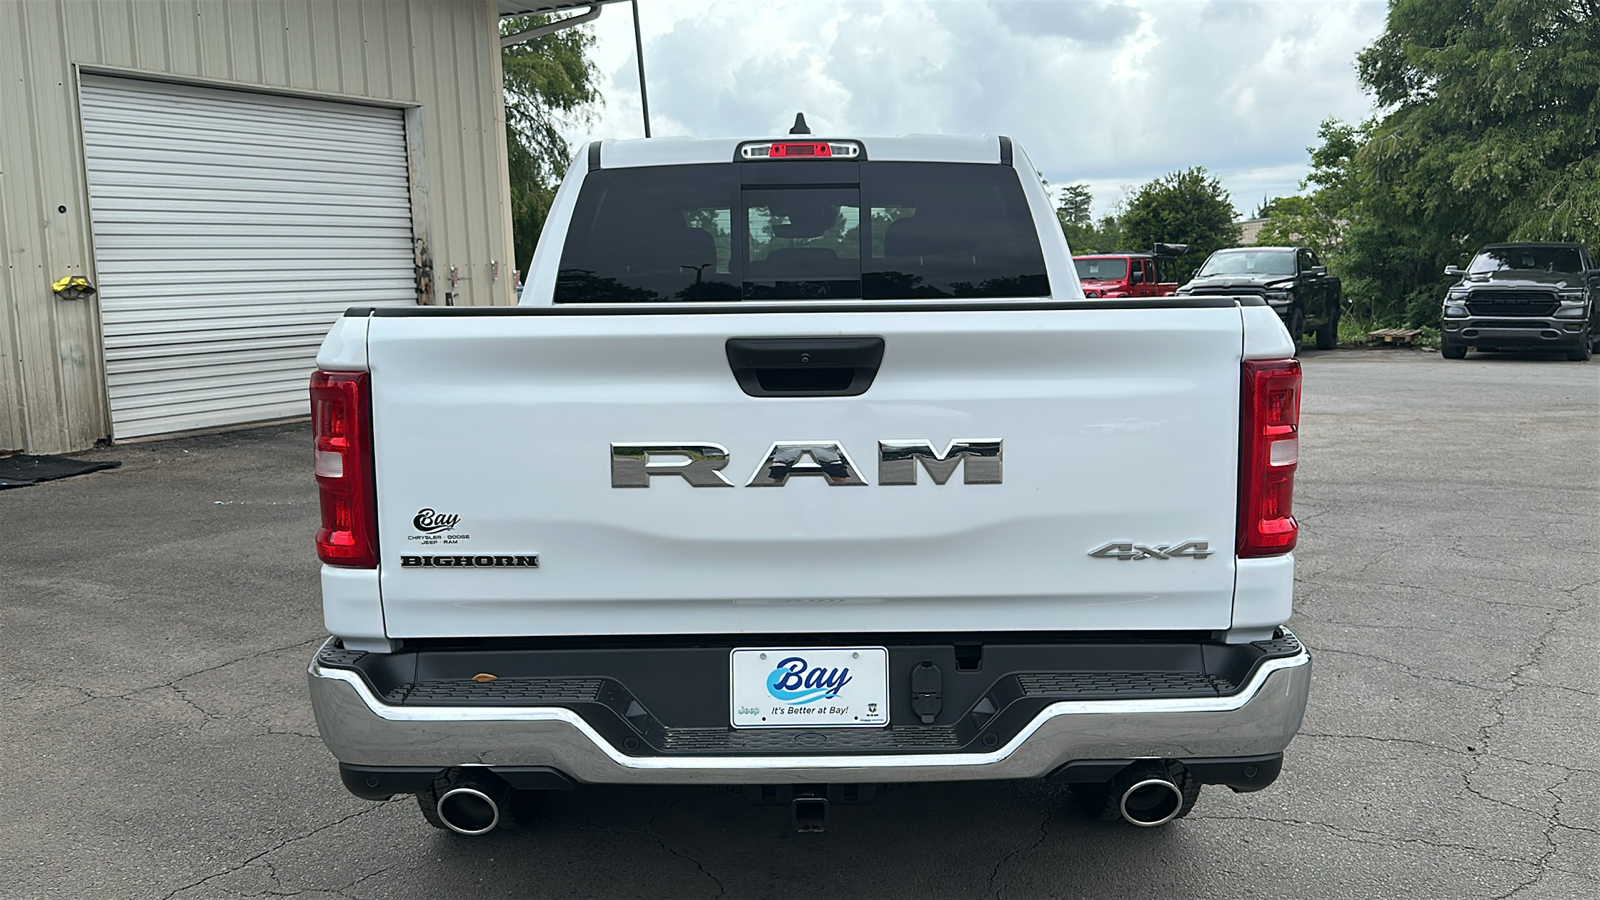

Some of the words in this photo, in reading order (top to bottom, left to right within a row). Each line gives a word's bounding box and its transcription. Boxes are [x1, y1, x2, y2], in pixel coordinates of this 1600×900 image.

[609, 438, 1004, 488] RAM
[418, 507, 461, 531] Bay
[400, 554, 539, 568] BIGHORN
[1087, 540, 1215, 561] 4x4
[773, 657, 852, 699] Bay
[738, 706, 760, 716] Jeep
[771, 707, 785, 715] It's
[787, 707, 815, 715] Better
[829, 706, 849, 715] Bay!
